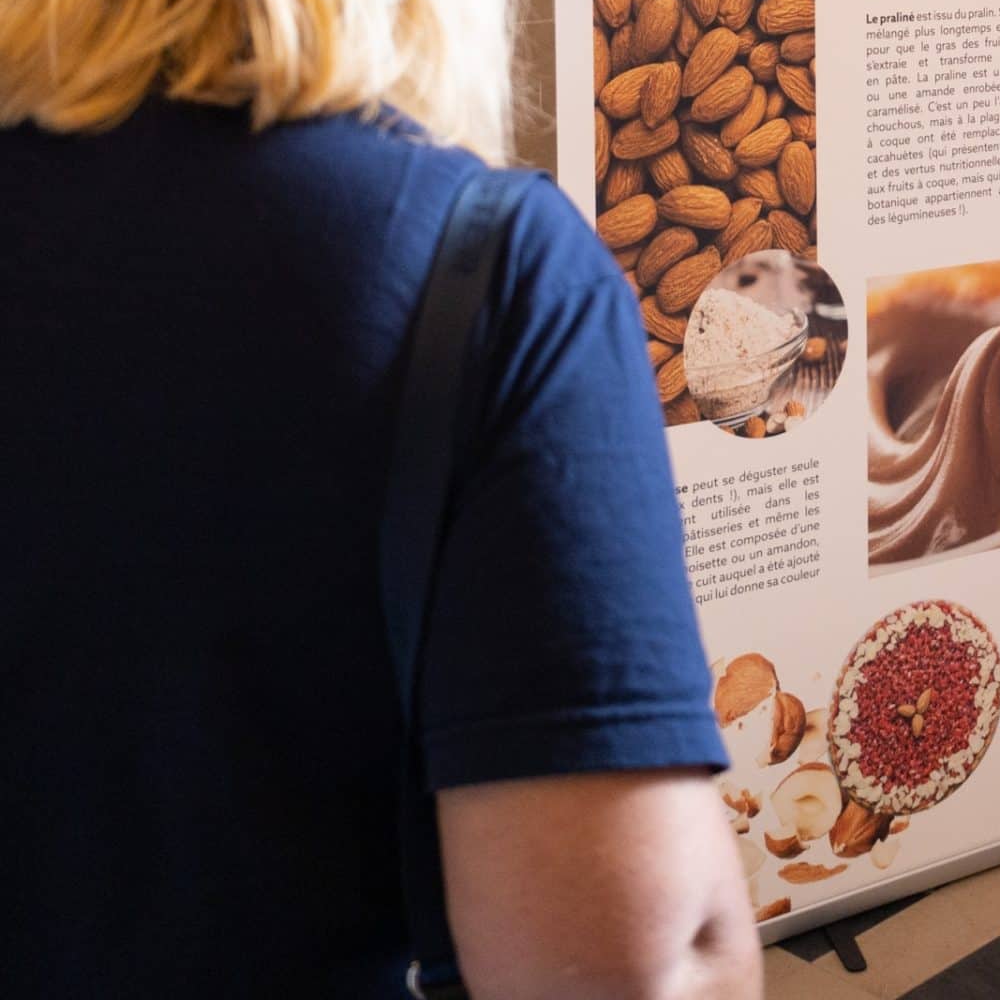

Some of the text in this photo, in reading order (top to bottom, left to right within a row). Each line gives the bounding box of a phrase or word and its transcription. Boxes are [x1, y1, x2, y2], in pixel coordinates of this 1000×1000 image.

[866, 27, 910, 41] mélangé
[914, 25, 936, 39] plus
[939, 24, 992, 37] longtemps
[692, 458, 819, 494] peut se déguster seule
[711, 489, 820, 520] utilisée dans les
